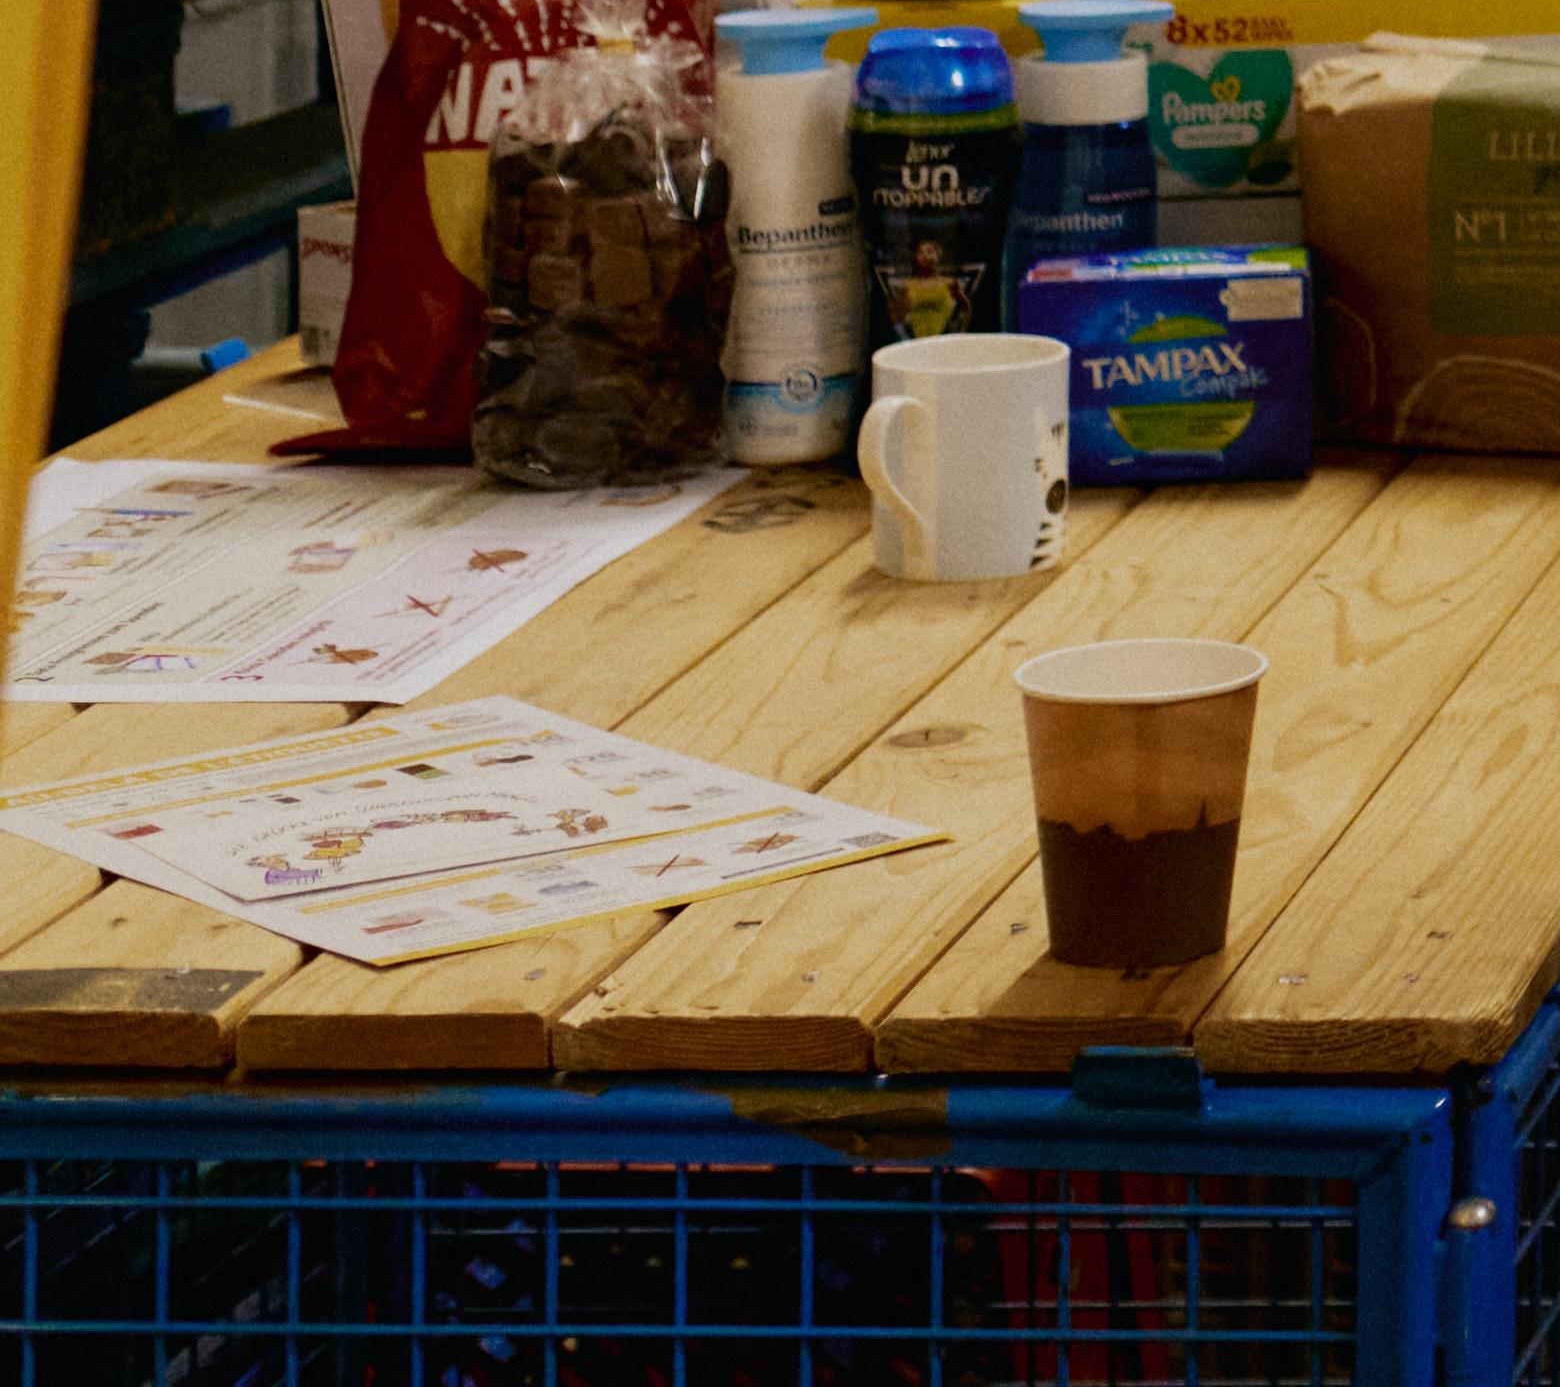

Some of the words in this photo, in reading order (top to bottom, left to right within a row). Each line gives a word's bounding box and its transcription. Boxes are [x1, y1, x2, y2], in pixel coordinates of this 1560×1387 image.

[1162, 90, 1267, 126] Pampers
[738, 221, 852, 250] Bepanthen
[1081, 341, 1248, 390] TAMPAX
